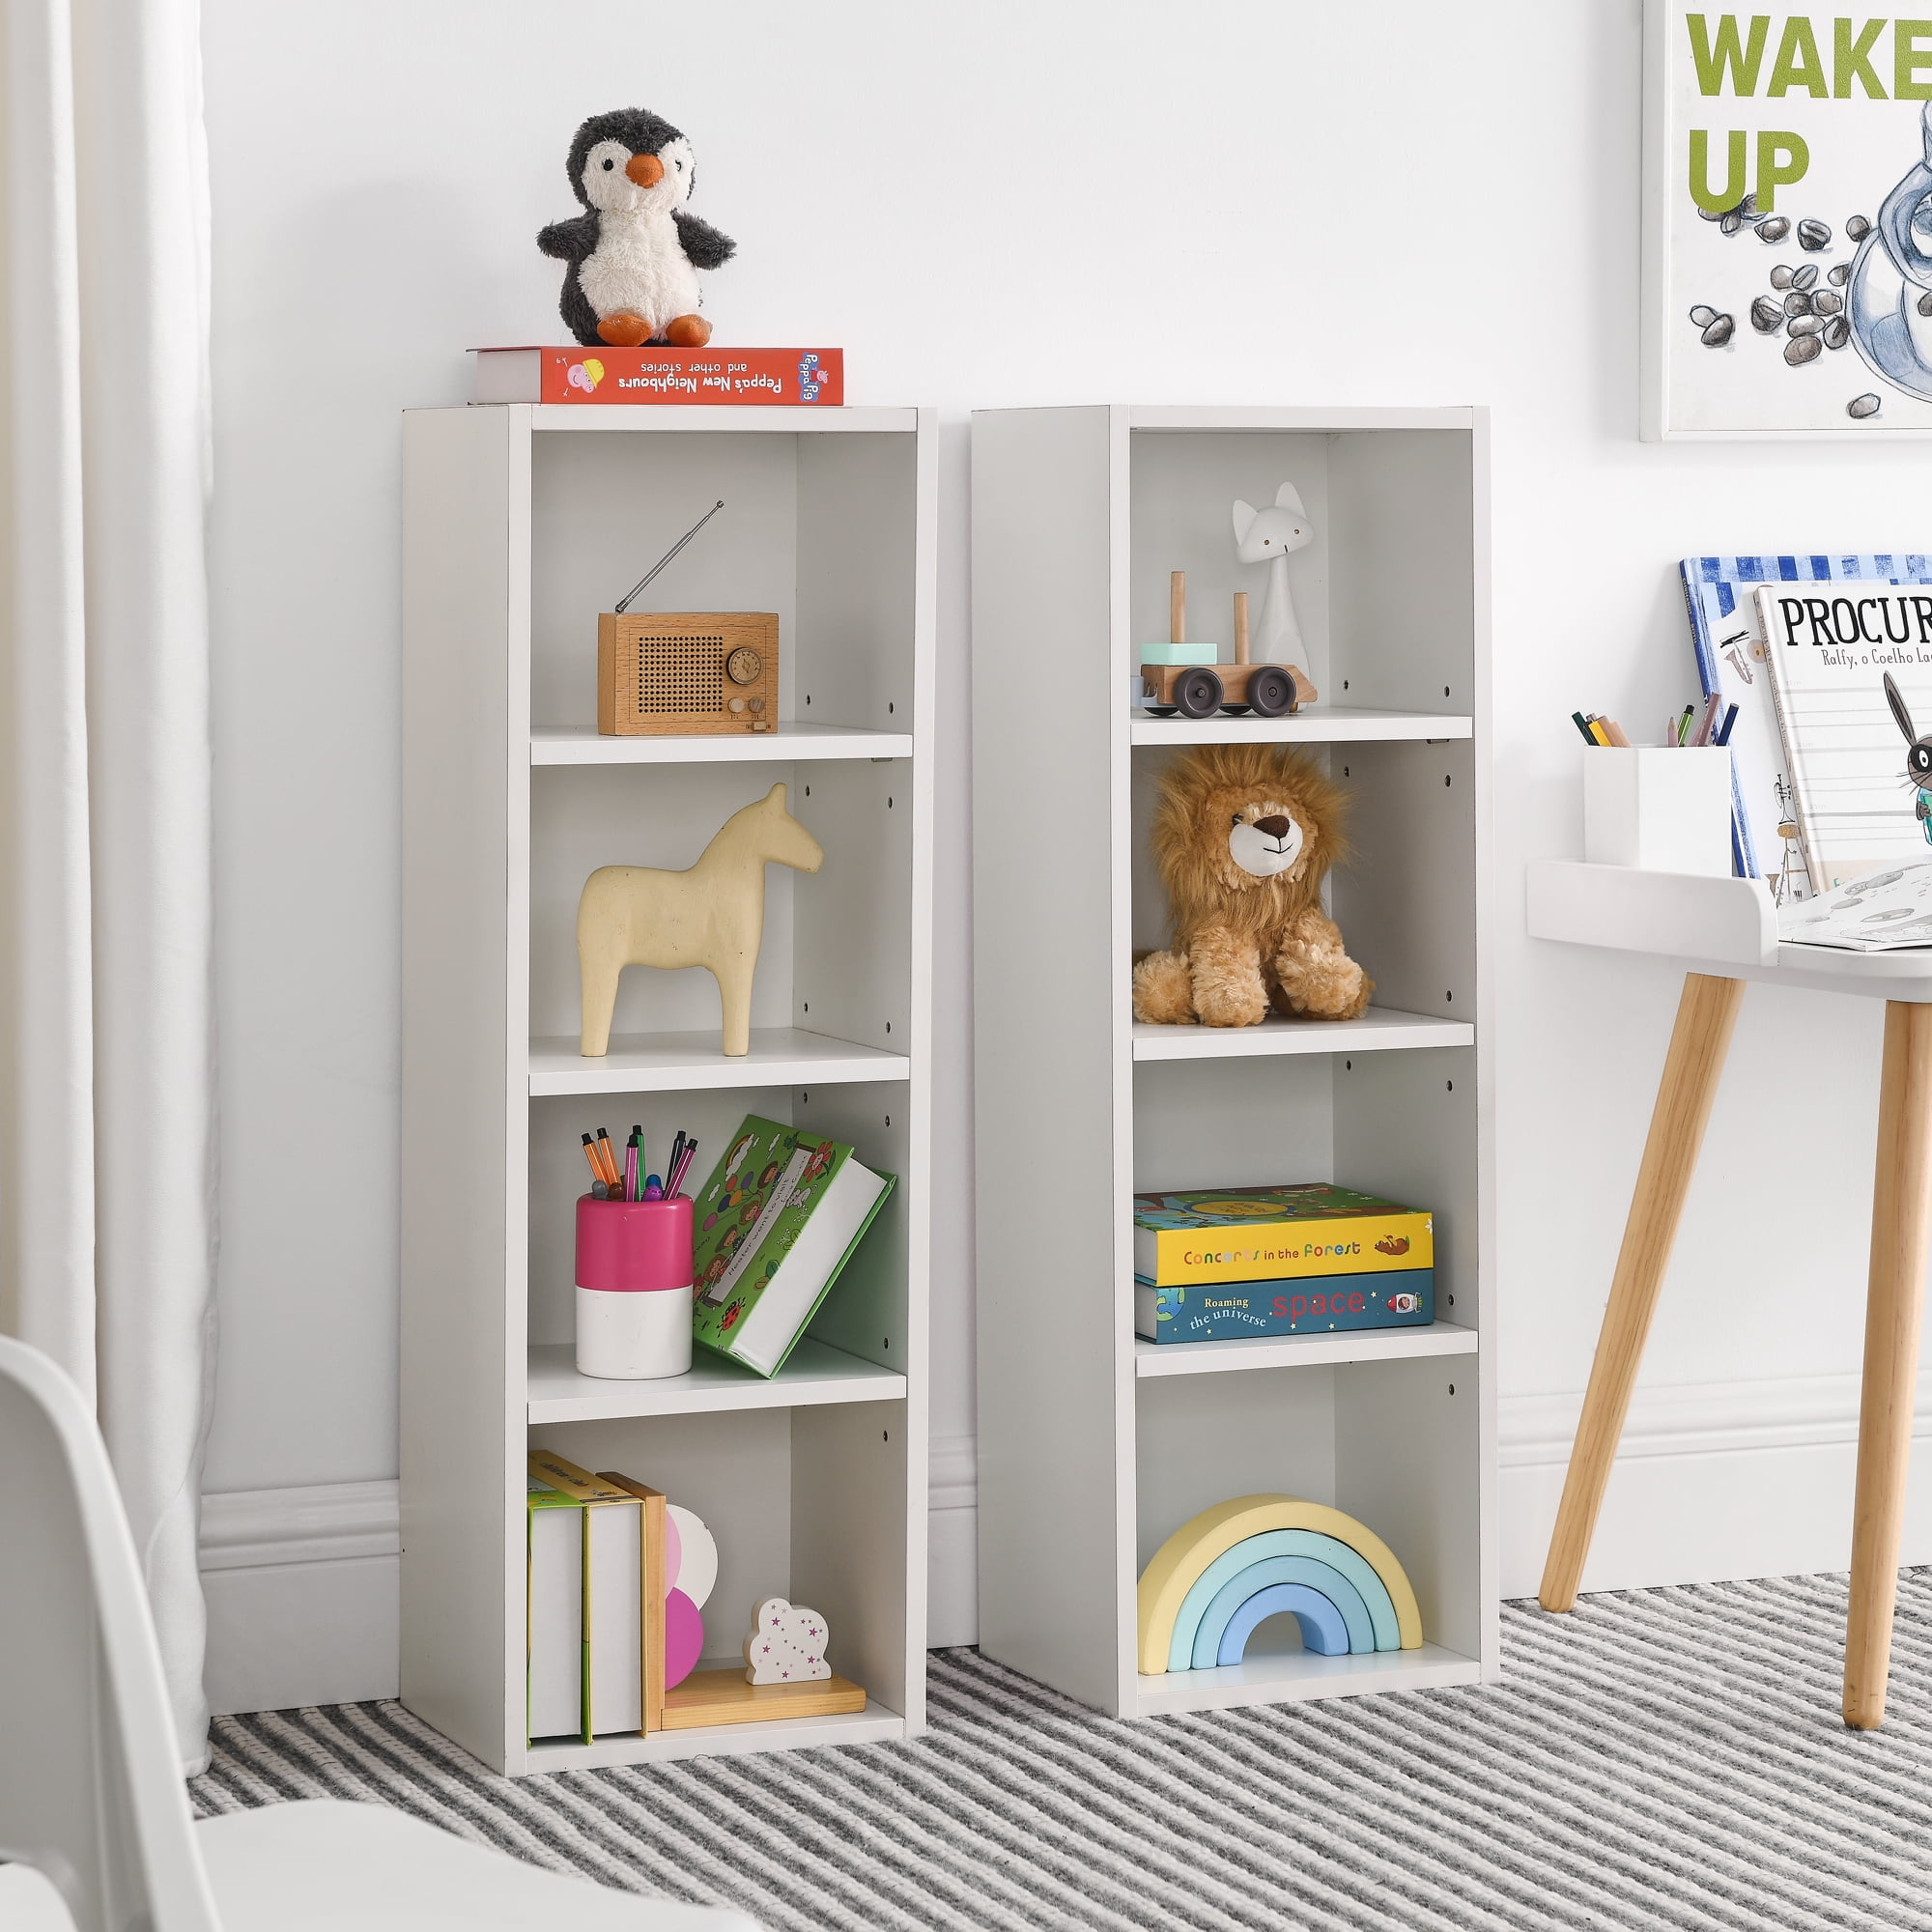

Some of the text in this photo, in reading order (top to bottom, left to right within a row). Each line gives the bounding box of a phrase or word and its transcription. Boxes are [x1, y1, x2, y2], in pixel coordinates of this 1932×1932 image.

[1686, 14, 1932, 100] WAKE
[1689, 129, 1809, 213] UP
[641, 363, 748, 374] and other stories
[800, 354, 818, 400] Peppa Pig
[618, 373, 782, 394] Peppa's New Neighbours
[1777, 596, 1932, 646] PROCUR
[1821, 647, 1932, 669] Ralfy, o Coelho La
[1183, 1249, 1260, 1264] Concerts
[1264, 1250, 1274, 1260] in
[1278, 1248, 1299, 1259] the
[1204, 1297, 1249, 1308] Roaming
[1272, 1291, 1365, 1322] space
[1189, 1307, 1266, 1330] the universe
